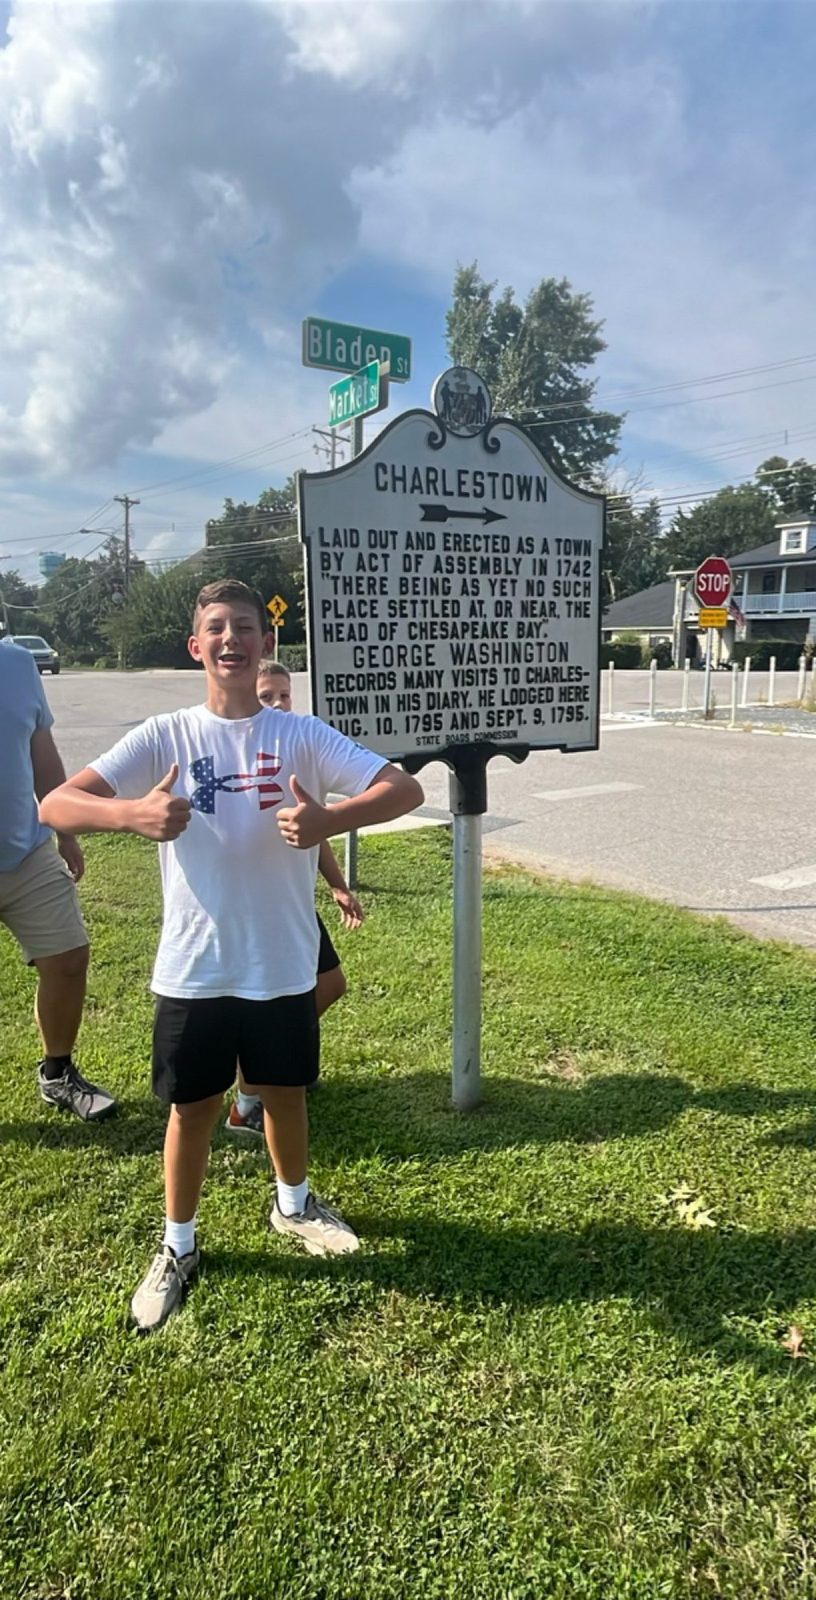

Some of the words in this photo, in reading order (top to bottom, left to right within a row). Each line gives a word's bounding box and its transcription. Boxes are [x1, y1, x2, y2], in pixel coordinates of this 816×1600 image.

[309, 324, 391, 366] Bladen
[396, 356, 409, 375] St
[329, 374, 369, 422] Market
[375, 462, 548, 502] CHARLESTOWN
[319, 526, 360, 549] LAID
[368, 529, 398, 550] OUT
[405, 531, 436, 551] AND
[443, 532, 510, 554] ERECTED
[516, 536, 535, 555] AS
[541, 537, 550, 555] A
[555, 538, 592, 557] TOWN
[320, 551, 344, 572] BY
[356, 552, 390, 573] ACT
[403, 553, 424, 573] OF
[433, 554, 522, 576] ASSEMBLY
[532, 558, 548, 577] IN
[557, 559, 592, 578] 1742
[321, 572, 389, 596] "THERE
[400, 576, 452, 596] BEING
[460, 578, 480, 597] AS
[488, 579, 518, 597] YET
[526, 579, 545, 598] NO
[552, 580, 592, 598] SUCH
[698, 573, 730, 592] STOP
[321, 599, 379, 619] PLACE
[387, 599, 461, 619] SETTLED
[469, 600, 487, 619] AT,
[494, 600, 513, 619] OR
[520, 600, 560, 620] NEAR,
[566, 601, 591, 619] THE
[323, 622, 369, 642] HEAD
[378, 622, 398, 641] OF
[408, 621, 508, 641] CHESAPEAKE
[353, 643, 436, 669] GEORGE
[449, 641, 569, 666] WASHINGTON
[325, 671, 397, 694] RECORDS
[404, 669, 444, 690] MANY
[452, 667, 498, 688] VISITS
[503, 667, 520, 686] TO
[525, 665, 590, 684] CHARLES-
[326, 695, 369, 716] TOWN
[376, 694, 390, 714] IN
[397, 692, 421, 713] HIS
[427, 690, 472, 711] DIARY.
[478, 689, 496, 708] HE
[501, 686, 555, 706] LODGED
[558, 685, 590, 703] HERE
[376, 716, 398, 736] 10,
[405, 712, 444, 735] 1795
[450, 711, 480, 731] AND
[486, 708, 527, 729] SEPT.
[551, 704, 589, 724] 1795.
[415, 735, 441, 746] STATE
